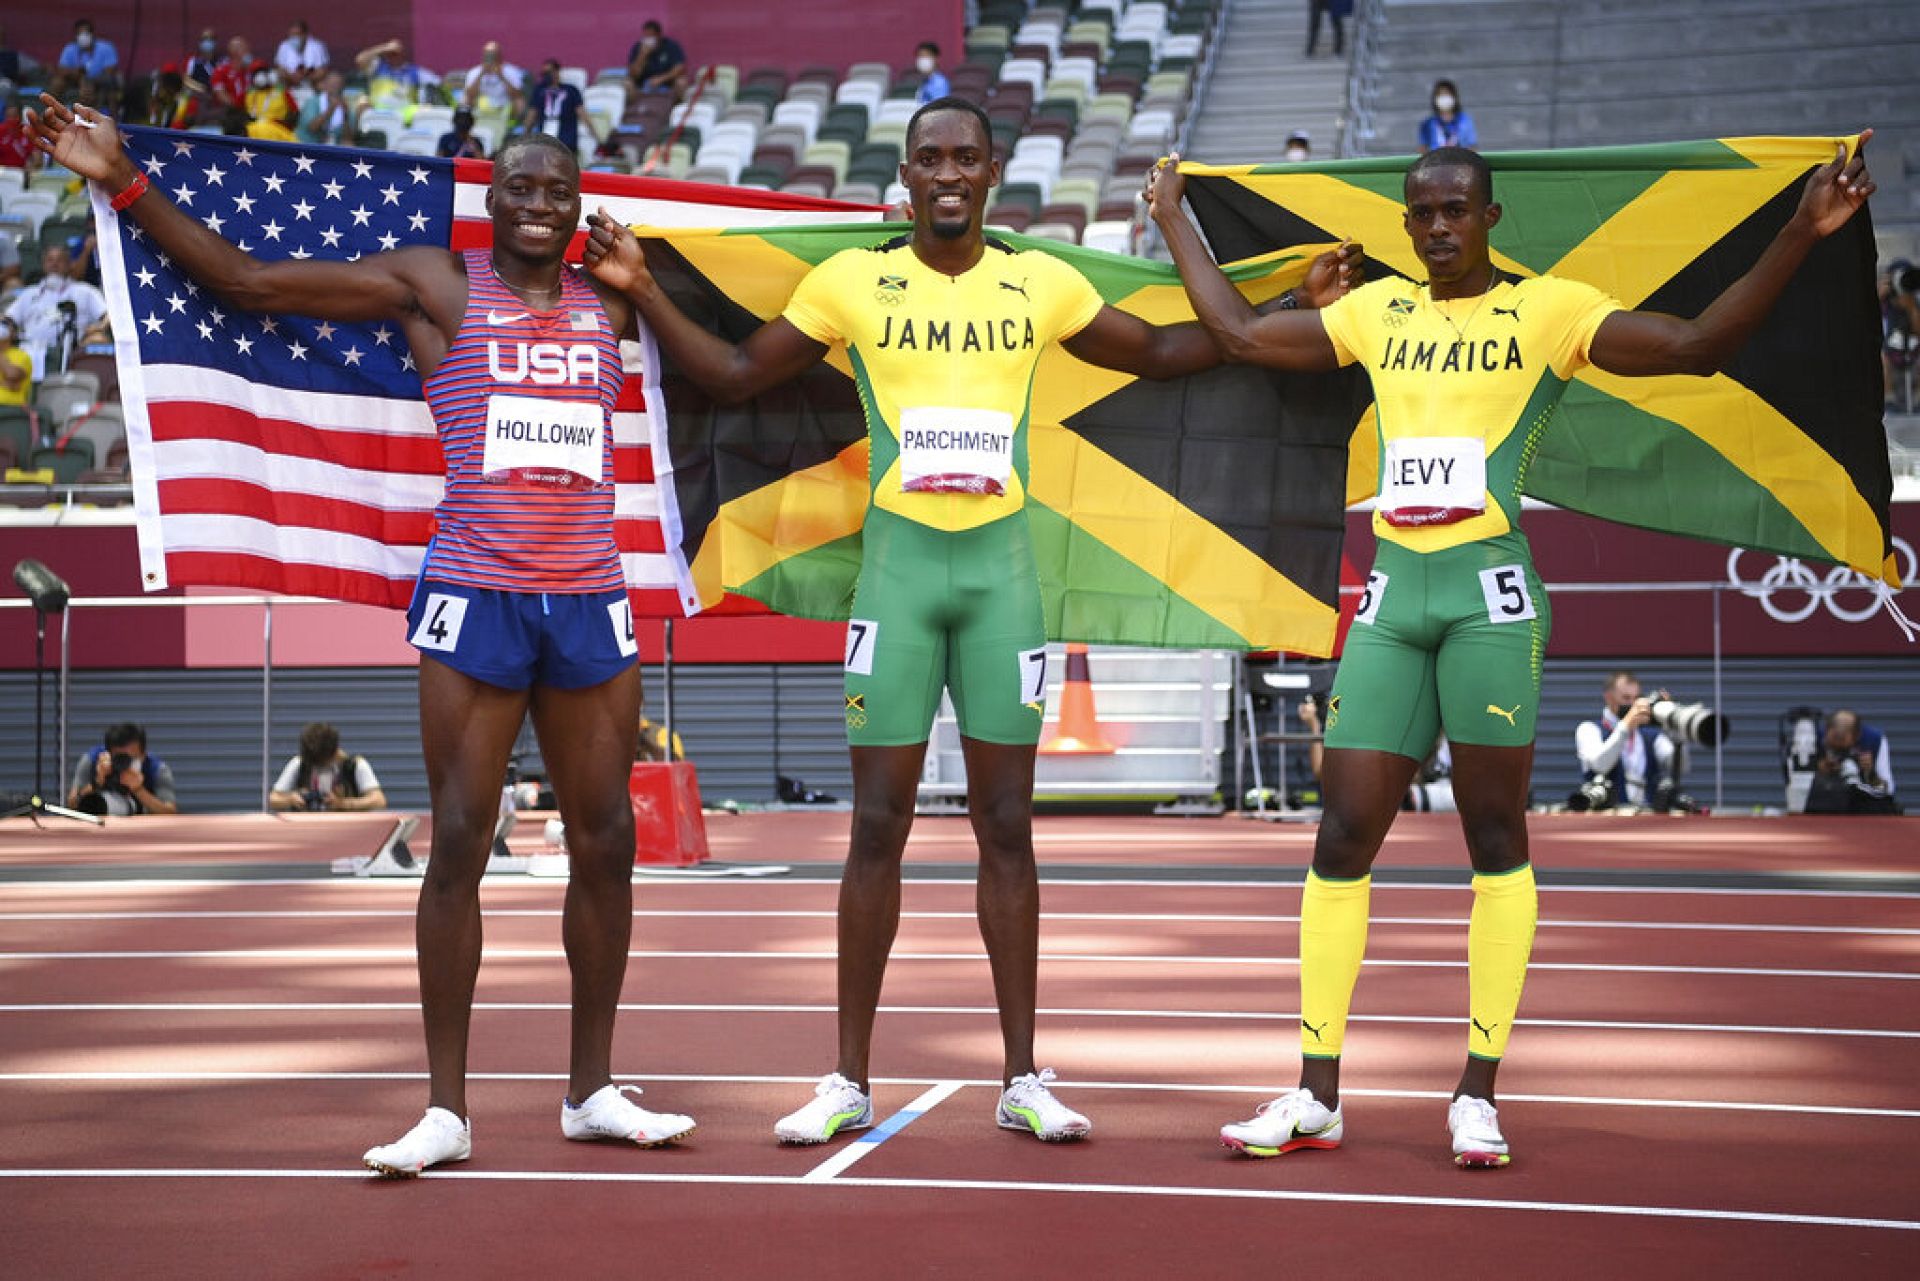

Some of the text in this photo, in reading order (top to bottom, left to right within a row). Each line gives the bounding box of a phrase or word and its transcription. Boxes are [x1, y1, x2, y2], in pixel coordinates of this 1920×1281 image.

[877, 316, 1034, 351] JAMAICA
[487, 341, 599, 384] USA
[1380, 336, 1523, 372] JAMAICA
[496, 419, 595, 447] HOLLOWAY
[904, 430, 1009, 454] PARCHMENT
[1392, 458, 1455, 486] LEVY
[1495, 570, 1525, 616] 5
[427, 600, 448, 644] 4
[847, 624, 866, 666] 7
[1029, 652, 1046, 697] 7
